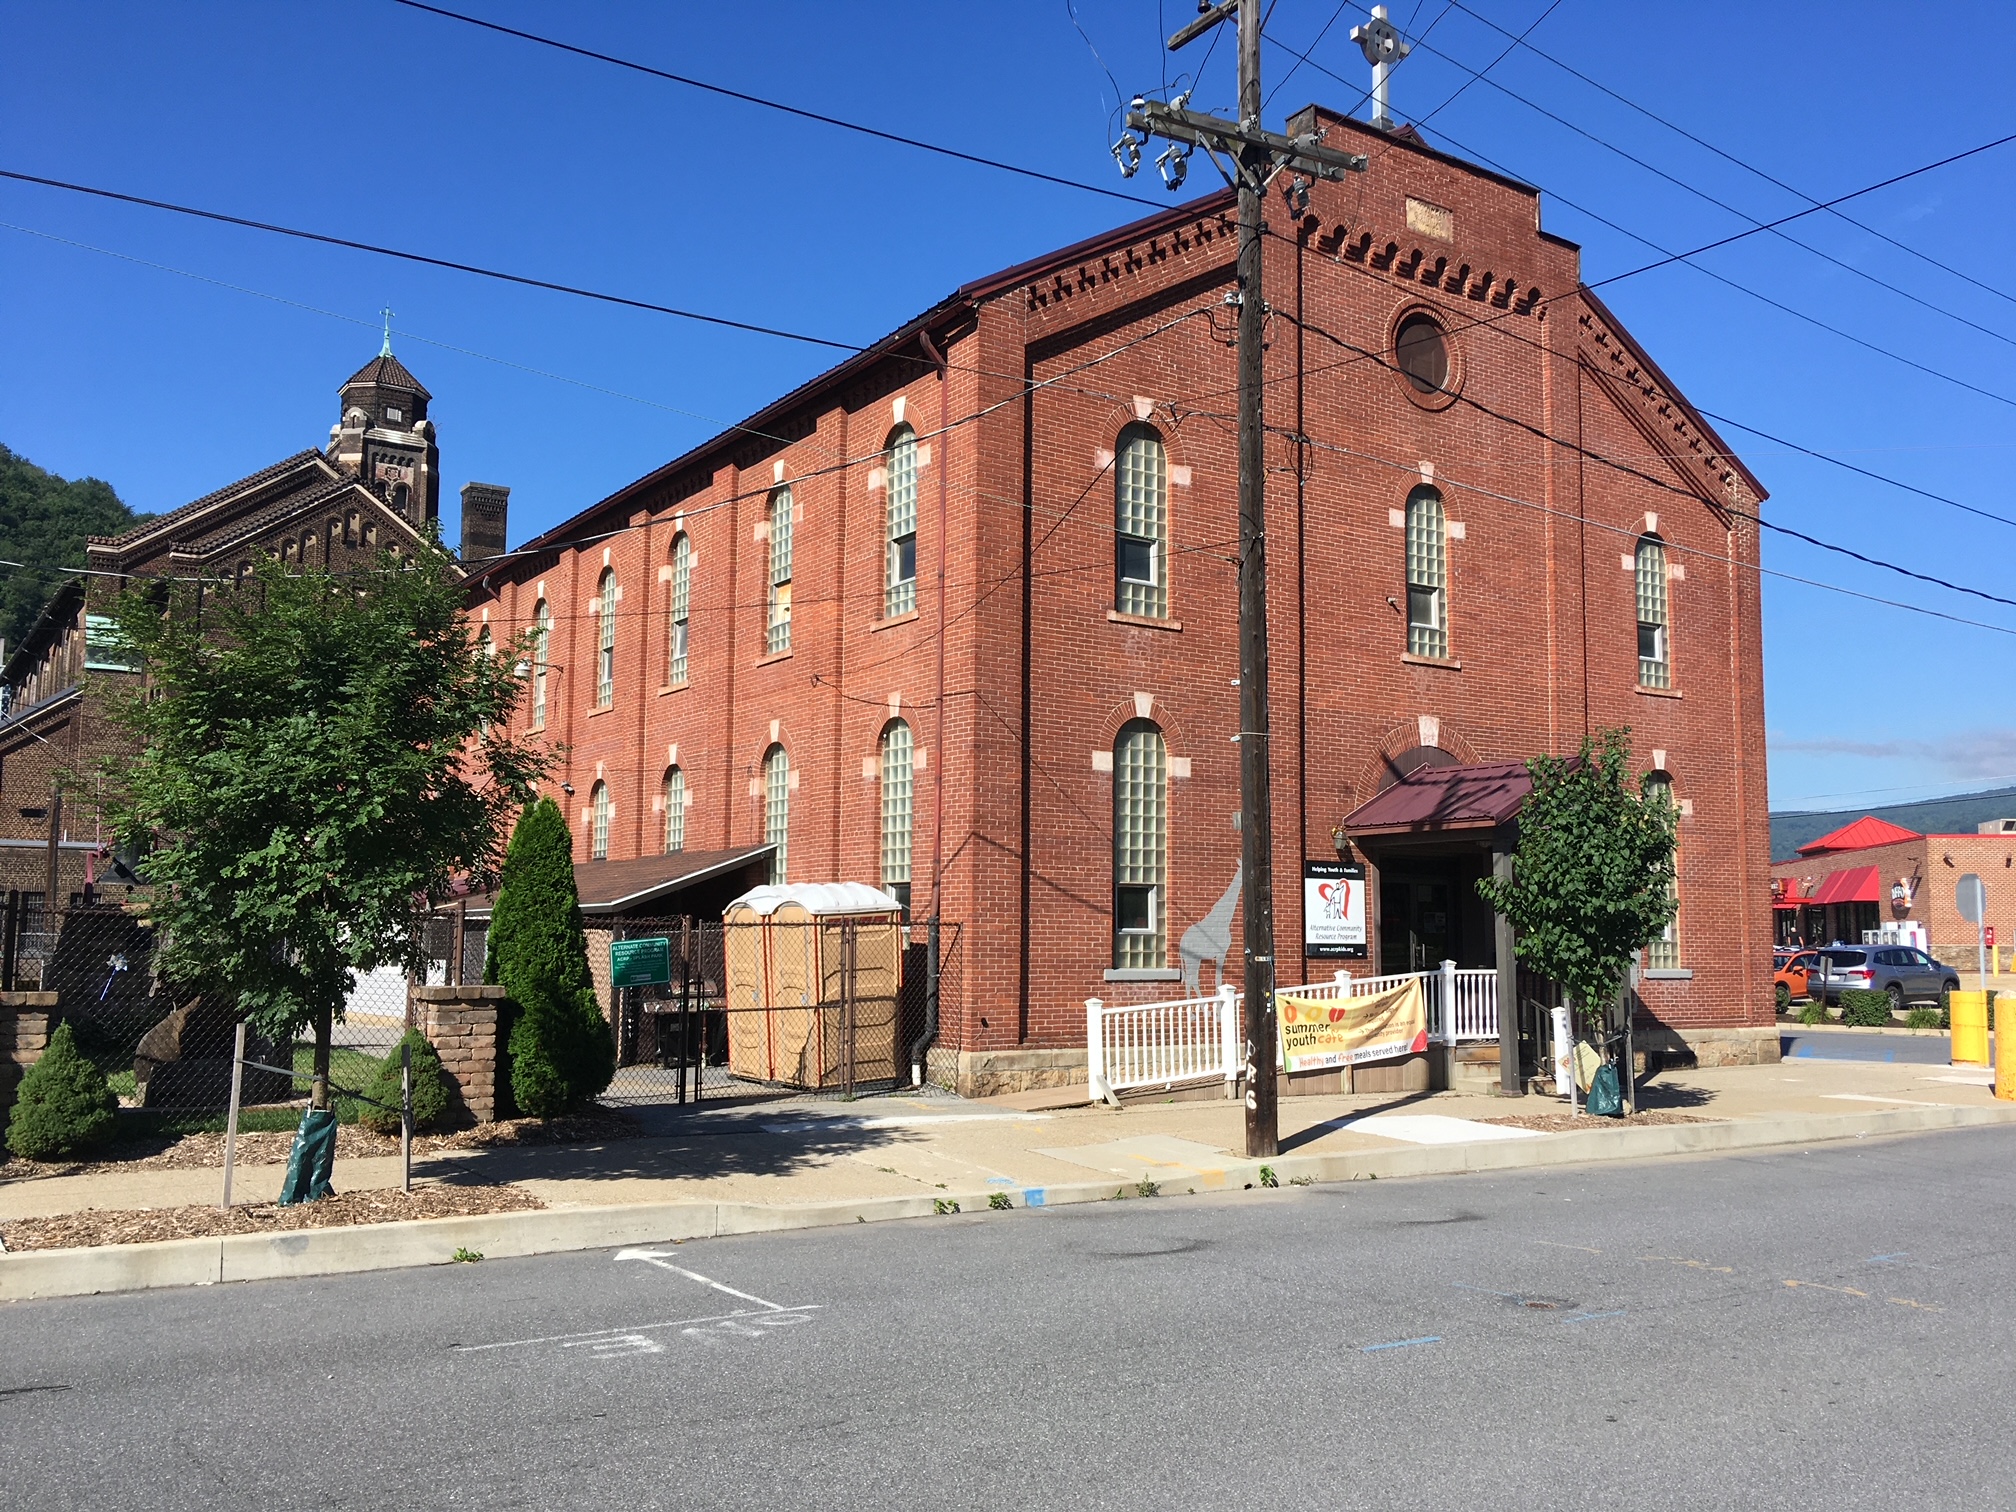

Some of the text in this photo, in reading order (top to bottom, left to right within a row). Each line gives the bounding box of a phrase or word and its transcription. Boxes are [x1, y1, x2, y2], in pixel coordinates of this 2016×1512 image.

[1285, 1024, 1330, 1034] summer
[1286, 1033, 1316, 1051] youth
[1300, 1056, 1324, 1067] Healthy
[1325, 1054, 1336, 1064] and
[1338, 1053, 1354, 1062] free
[1354, 1050, 1371, 1060] meals
[1372, 1046, 1393, 1057] served
